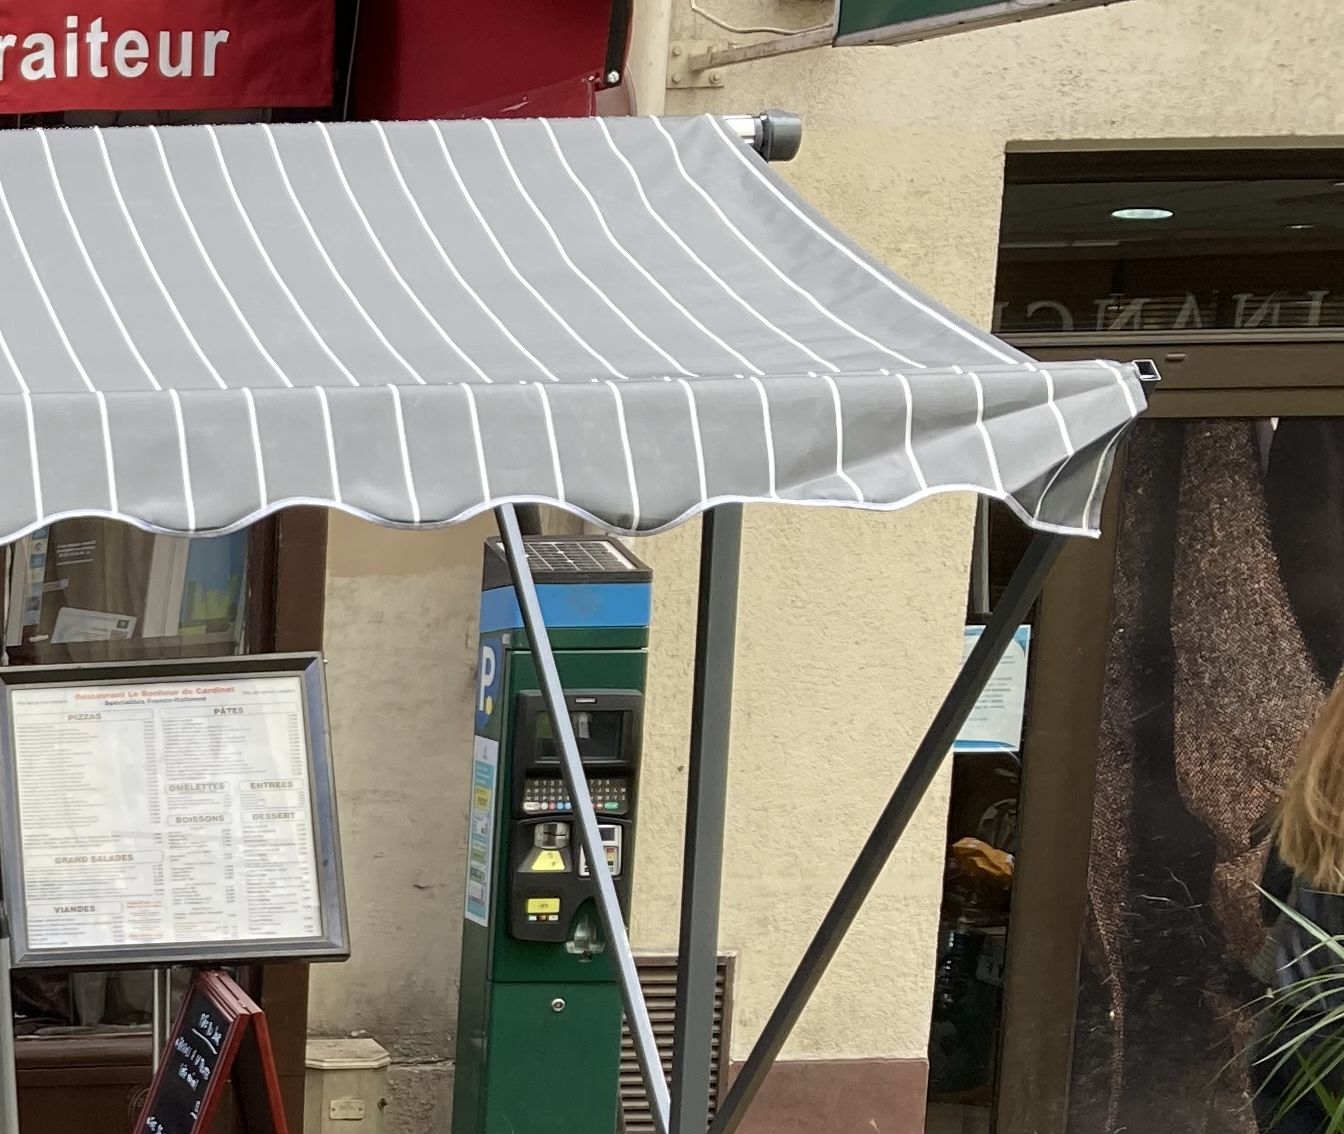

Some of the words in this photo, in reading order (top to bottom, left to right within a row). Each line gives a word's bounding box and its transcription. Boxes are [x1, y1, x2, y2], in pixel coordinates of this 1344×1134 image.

[478, 645, 496, 712] P
[213, 705, 244, 716] PÂTES
[67, 712, 102, 721] PIZZAS
[169, 782, 225, 793] OMELETTES
[250, 779, 294, 790] ENTREES
[175, 814, 225, 824] BOISSONS
[251, 811, 296, 821] DESSERT
[54, 854, 89, 864] GRAND
[90, 853, 134, 863] SALADES
[53, 904, 96, 914] VIANDES
